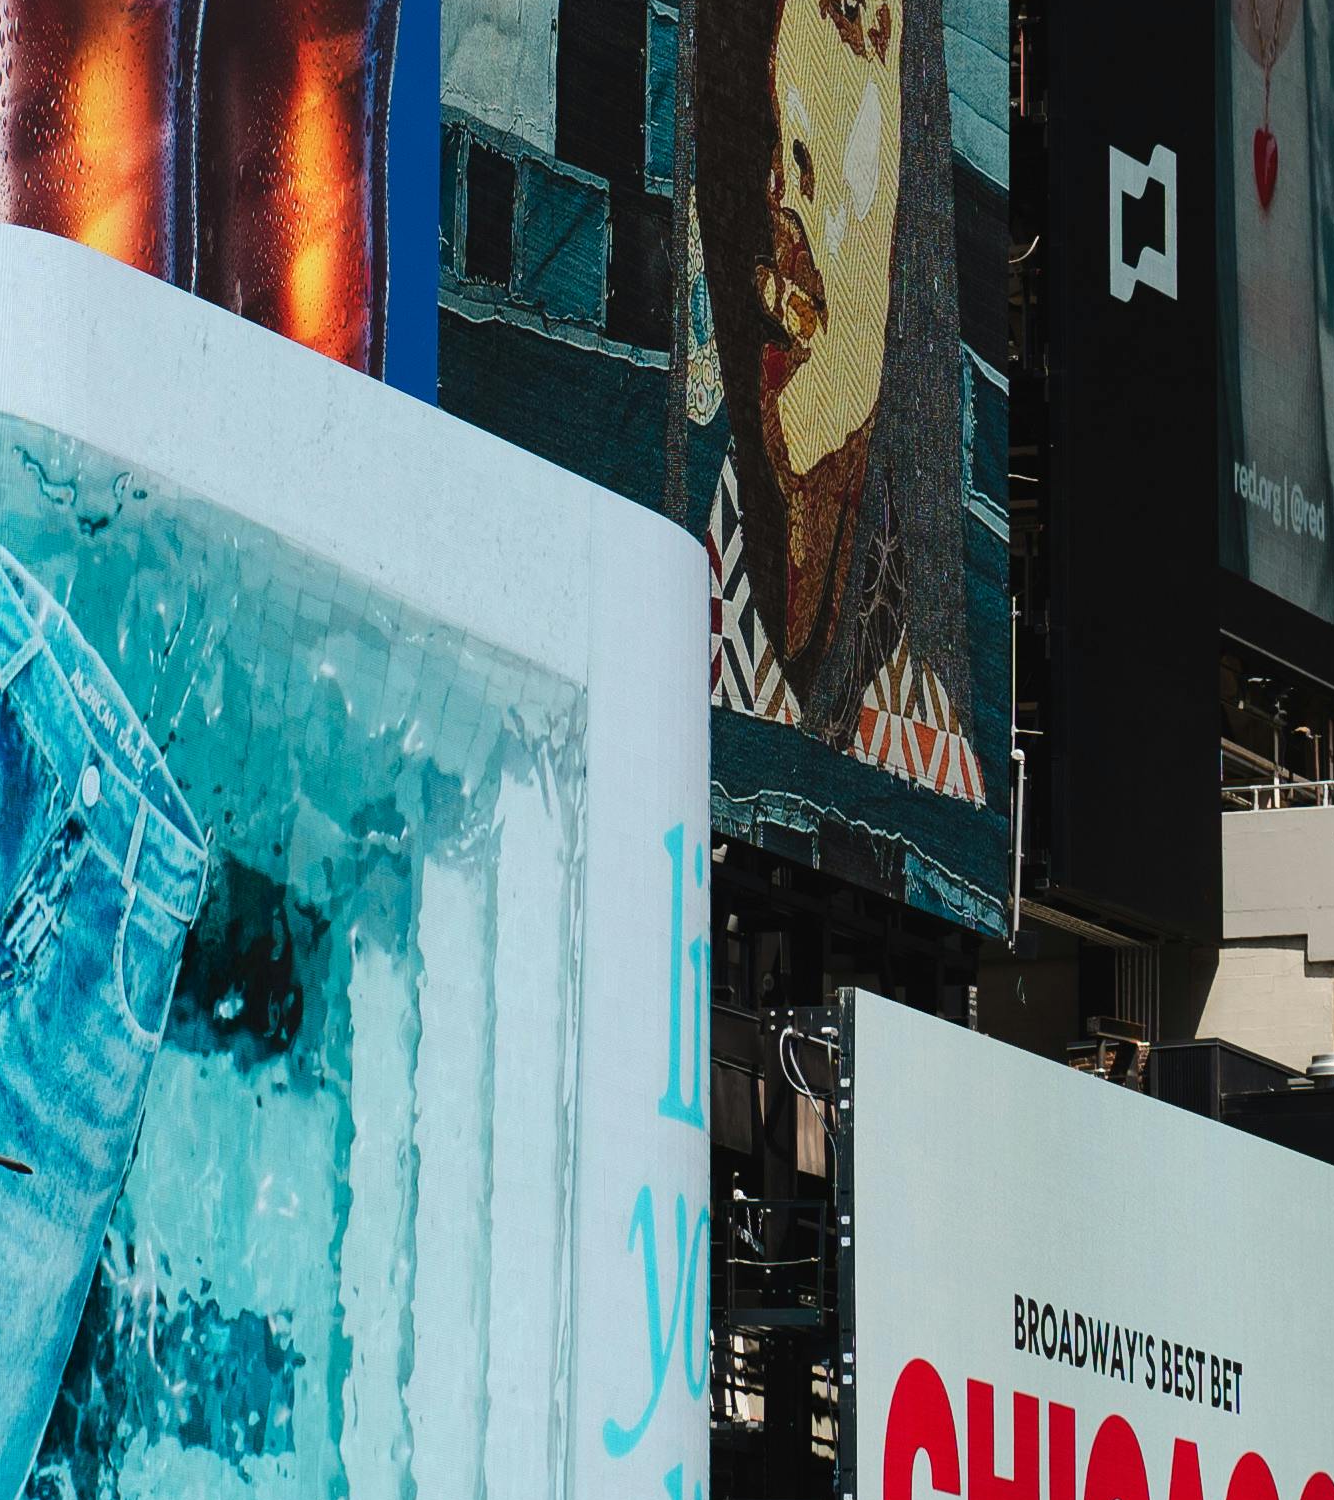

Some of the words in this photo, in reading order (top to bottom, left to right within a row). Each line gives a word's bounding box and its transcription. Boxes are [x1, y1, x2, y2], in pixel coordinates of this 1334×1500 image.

[1234, 458, 1282, 529] red.org
[1289, 482, 1326, 543] @red
[1013, 1293, 1156, 1391] BROADWAY'S
[1161, 1338, 1206, 1404] BEST
[1210, 1354, 1244, 1415] BET
